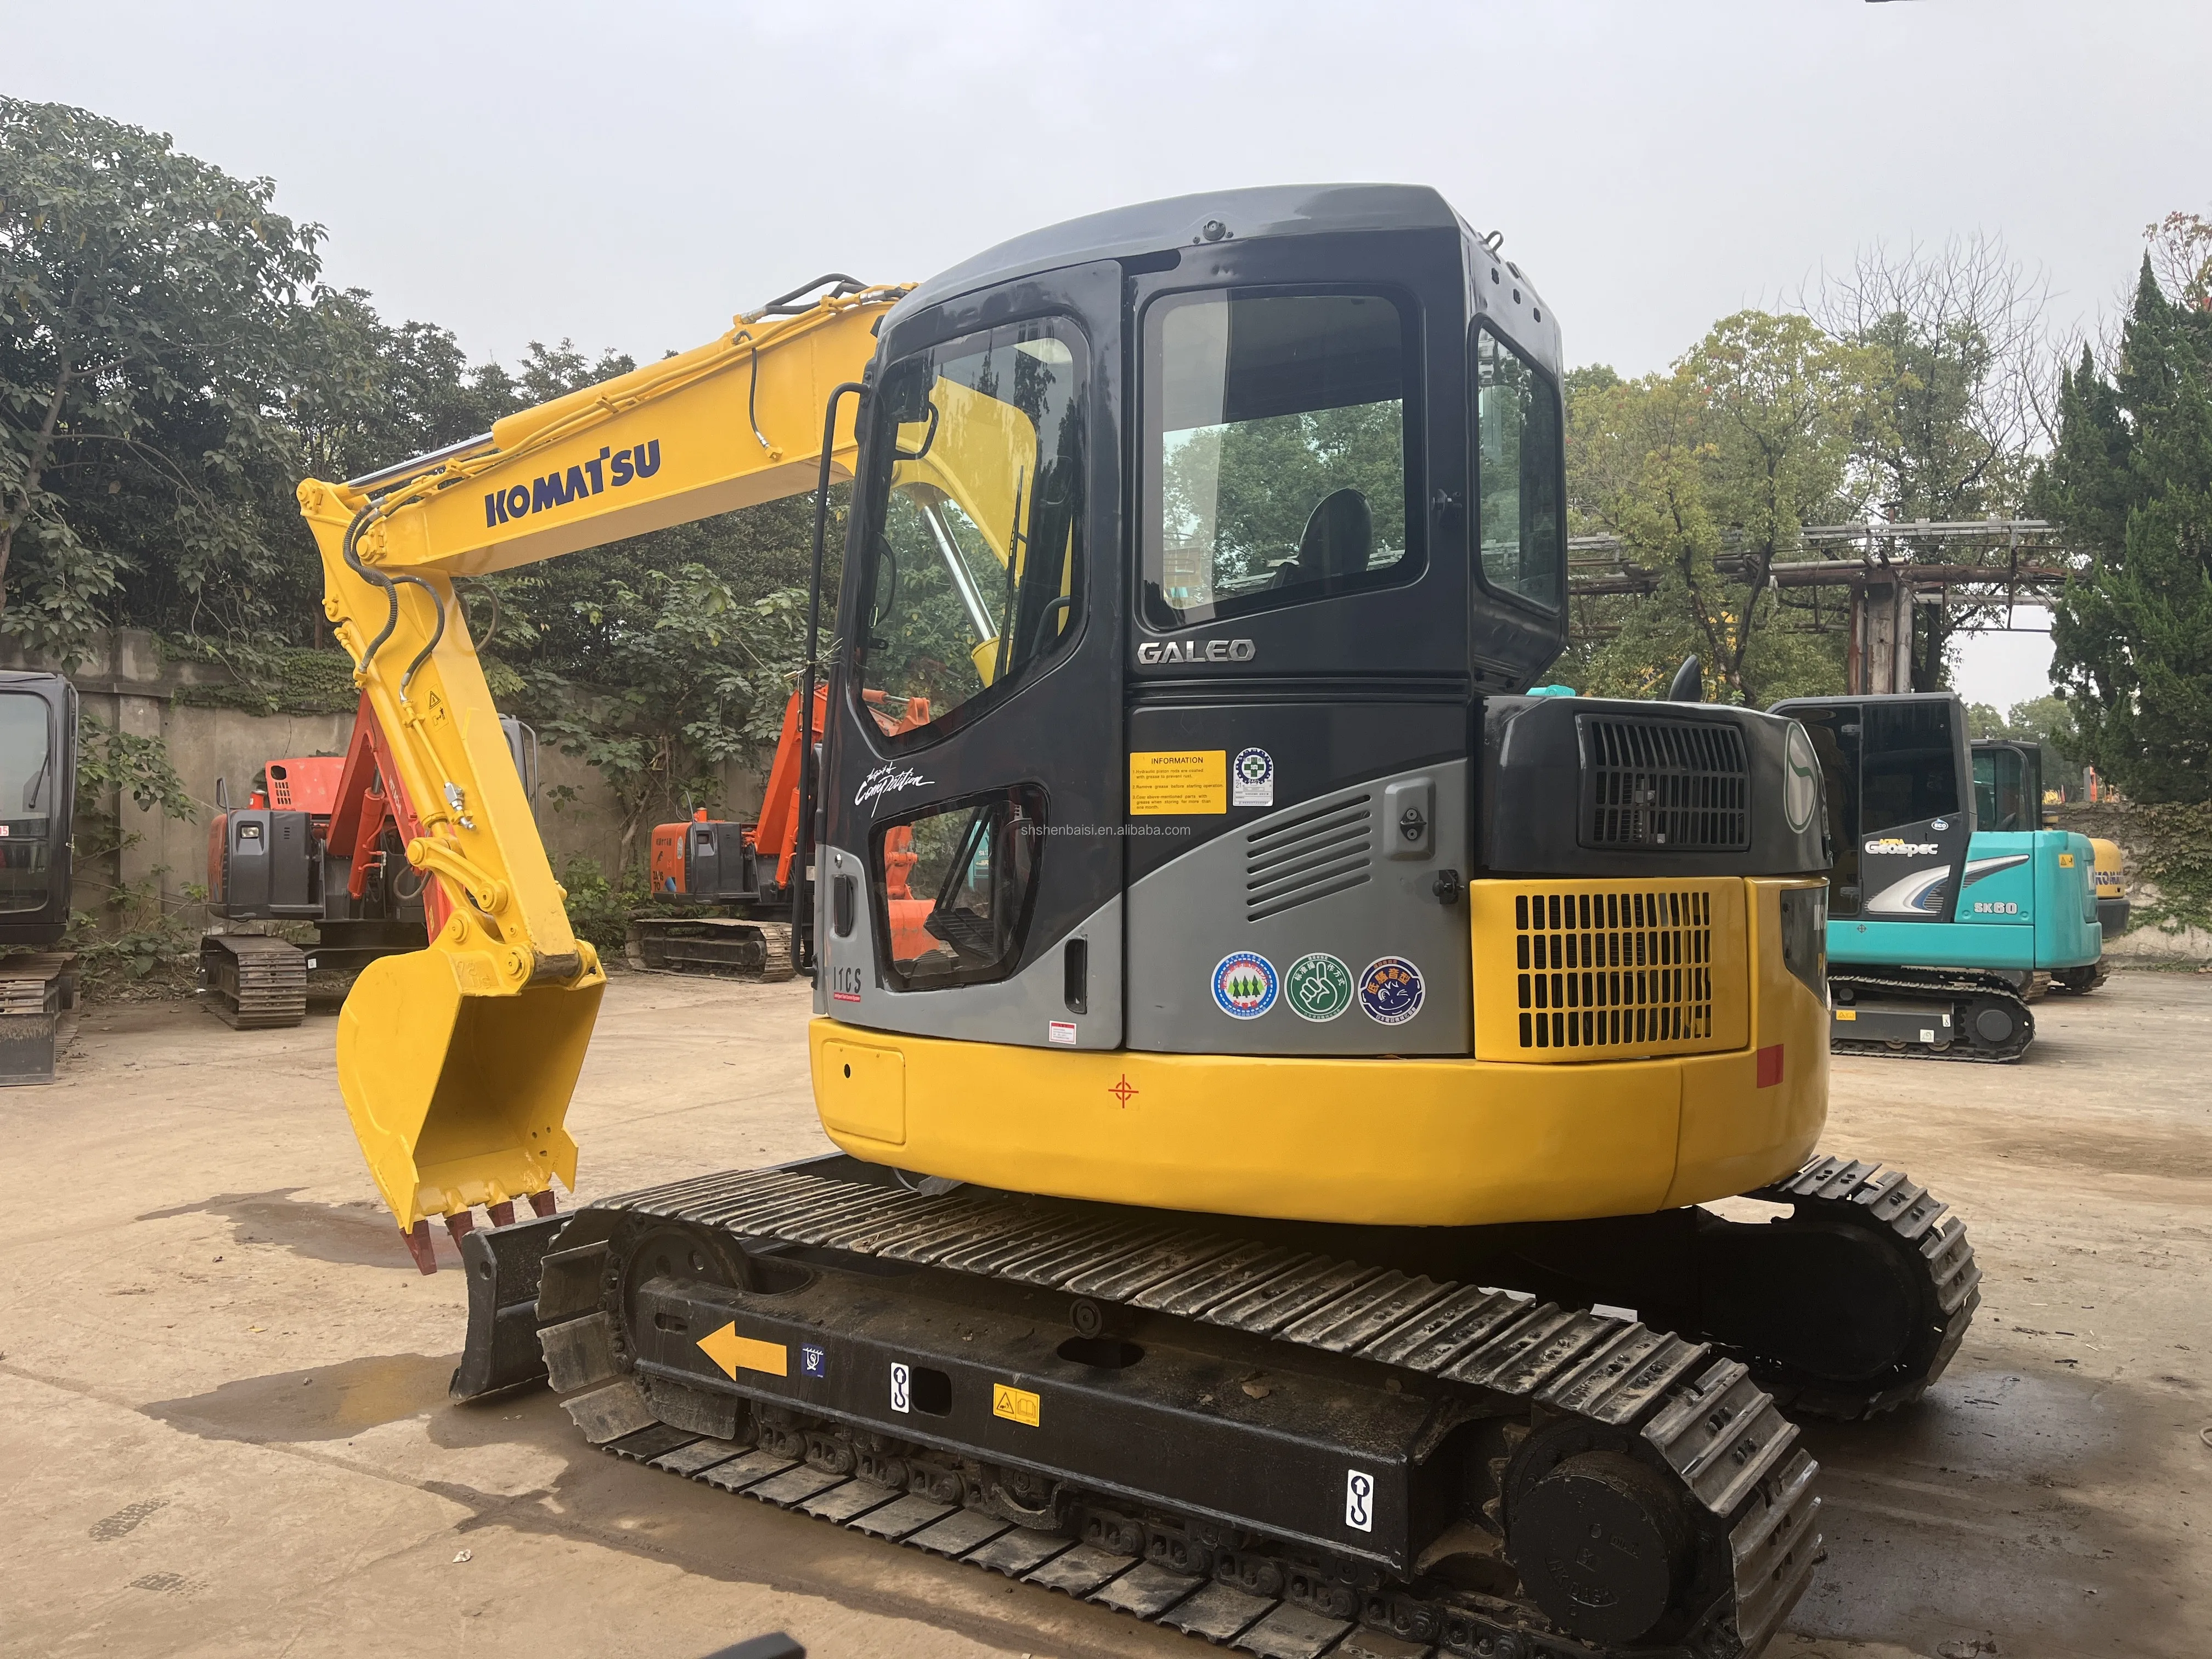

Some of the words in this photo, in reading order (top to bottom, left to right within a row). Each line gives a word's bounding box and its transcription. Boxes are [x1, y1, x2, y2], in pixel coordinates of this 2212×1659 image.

[484, 439, 661, 528] KOMATSU
[1137, 639, 1256, 664] GALEO
[1974, 901, 2018, 915] SK60
[833, 966, 861, 994] ITCS
